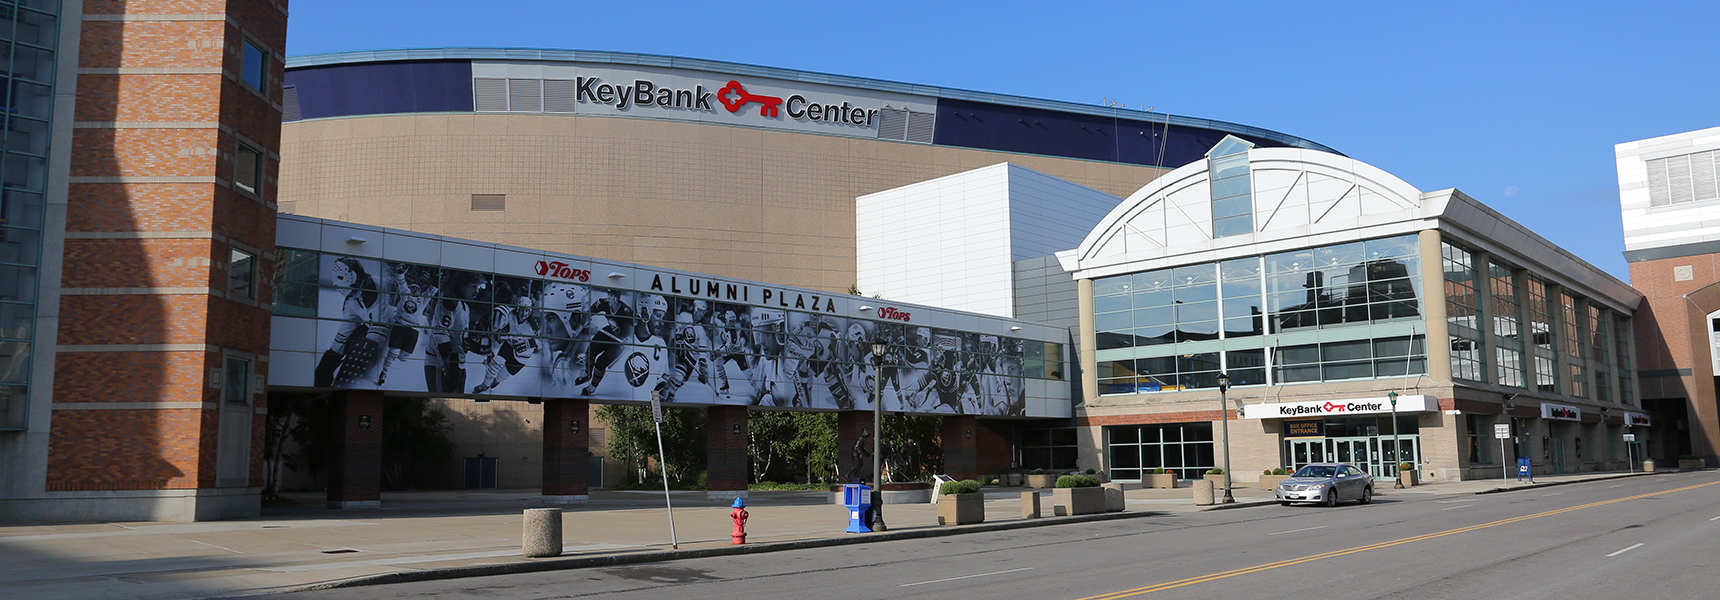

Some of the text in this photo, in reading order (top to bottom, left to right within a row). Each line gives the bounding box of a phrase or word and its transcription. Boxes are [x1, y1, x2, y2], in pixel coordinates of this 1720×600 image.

[575, 75, 878, 126] KeyBank Center
[650, 273, 836, 313] ALUMNI PLAZA
[1279, 402, 1382, 415] KeyBank Center
